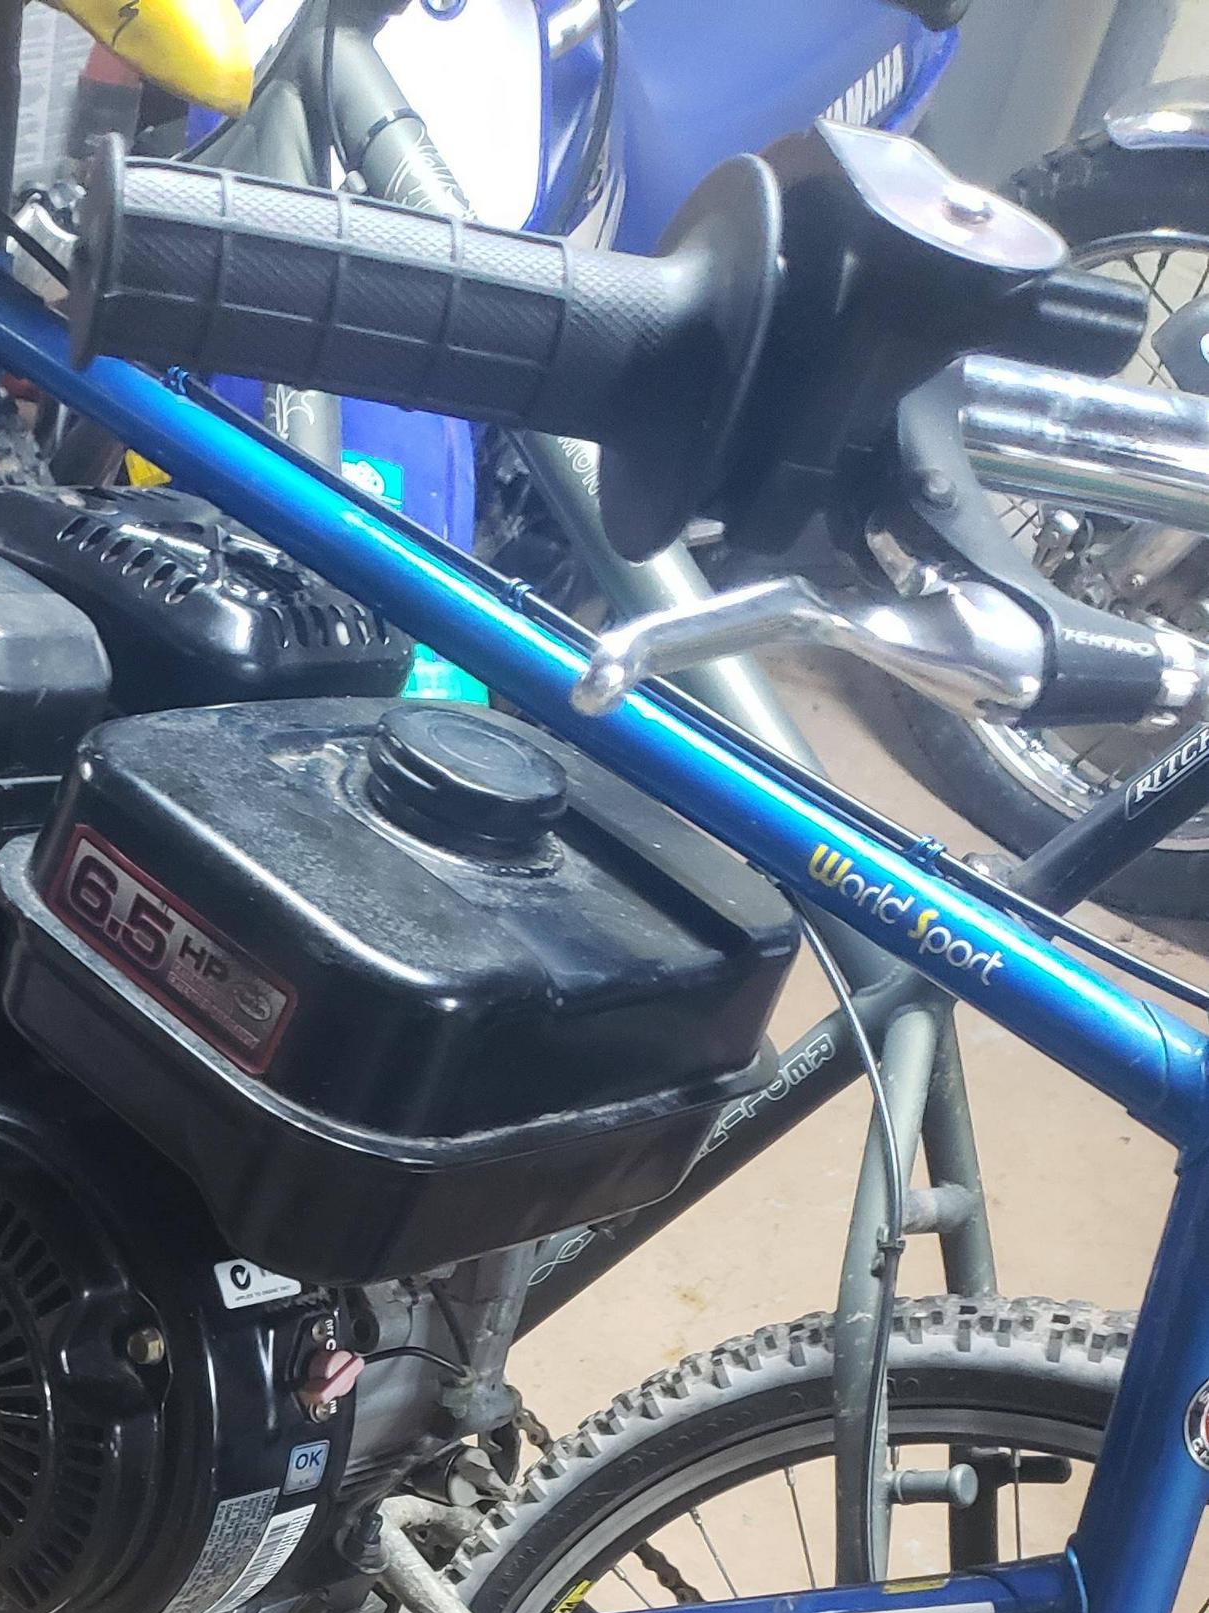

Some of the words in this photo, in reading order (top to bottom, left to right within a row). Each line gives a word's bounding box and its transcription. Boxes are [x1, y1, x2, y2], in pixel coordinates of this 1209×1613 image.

[816, 43, 904, 125] AMAHA
[68, 854, 176, 971] 6.5
[178, 934, 229, 983] HP
[808, 843, 916, 924] World
[907, 908, 1005, 986] Sport
[295, 1449, 322, 1470] OK
